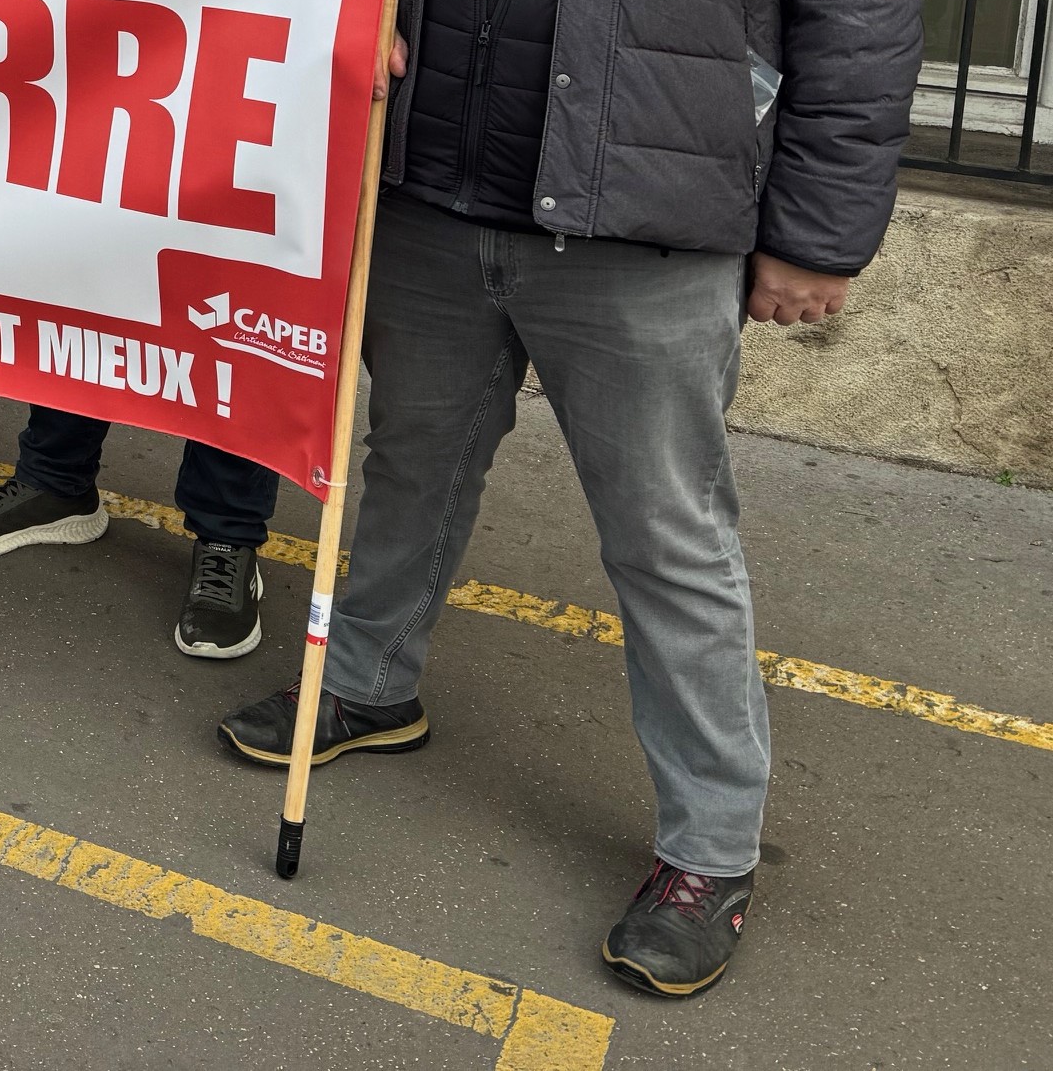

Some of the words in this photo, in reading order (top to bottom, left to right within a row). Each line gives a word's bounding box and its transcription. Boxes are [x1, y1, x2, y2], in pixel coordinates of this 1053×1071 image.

[234, 308, 327, 355] CAPEB
[234, 331, 277, 352] L'Artisanat
[278, 347, 286, 357] du
[288, 350, 327, 368] Bâtiment
[38, 320, 198, 408] MIEUX
[216, 361, 234, 419] !
